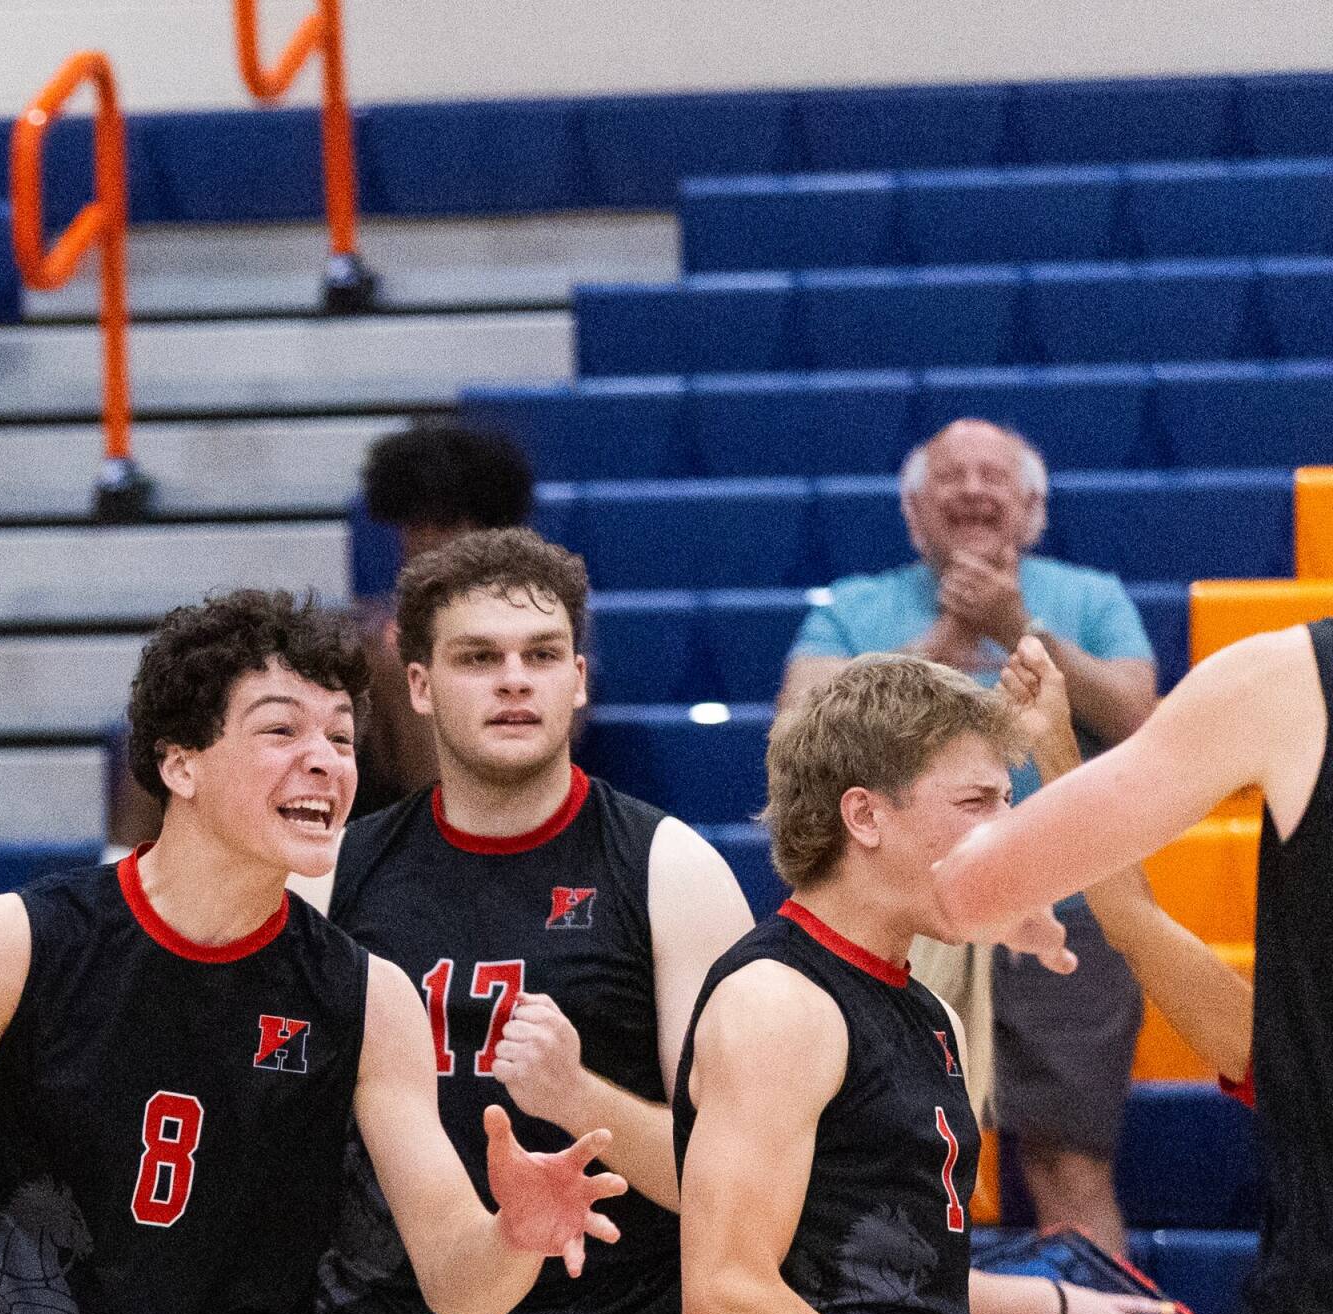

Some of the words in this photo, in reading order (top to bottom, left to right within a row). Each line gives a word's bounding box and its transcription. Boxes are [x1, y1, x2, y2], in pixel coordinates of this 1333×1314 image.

[422, 957, 525, 1077] 17
[131, 1090, 205, 1228] 8
[935, 1106, 964, 1233] 1
